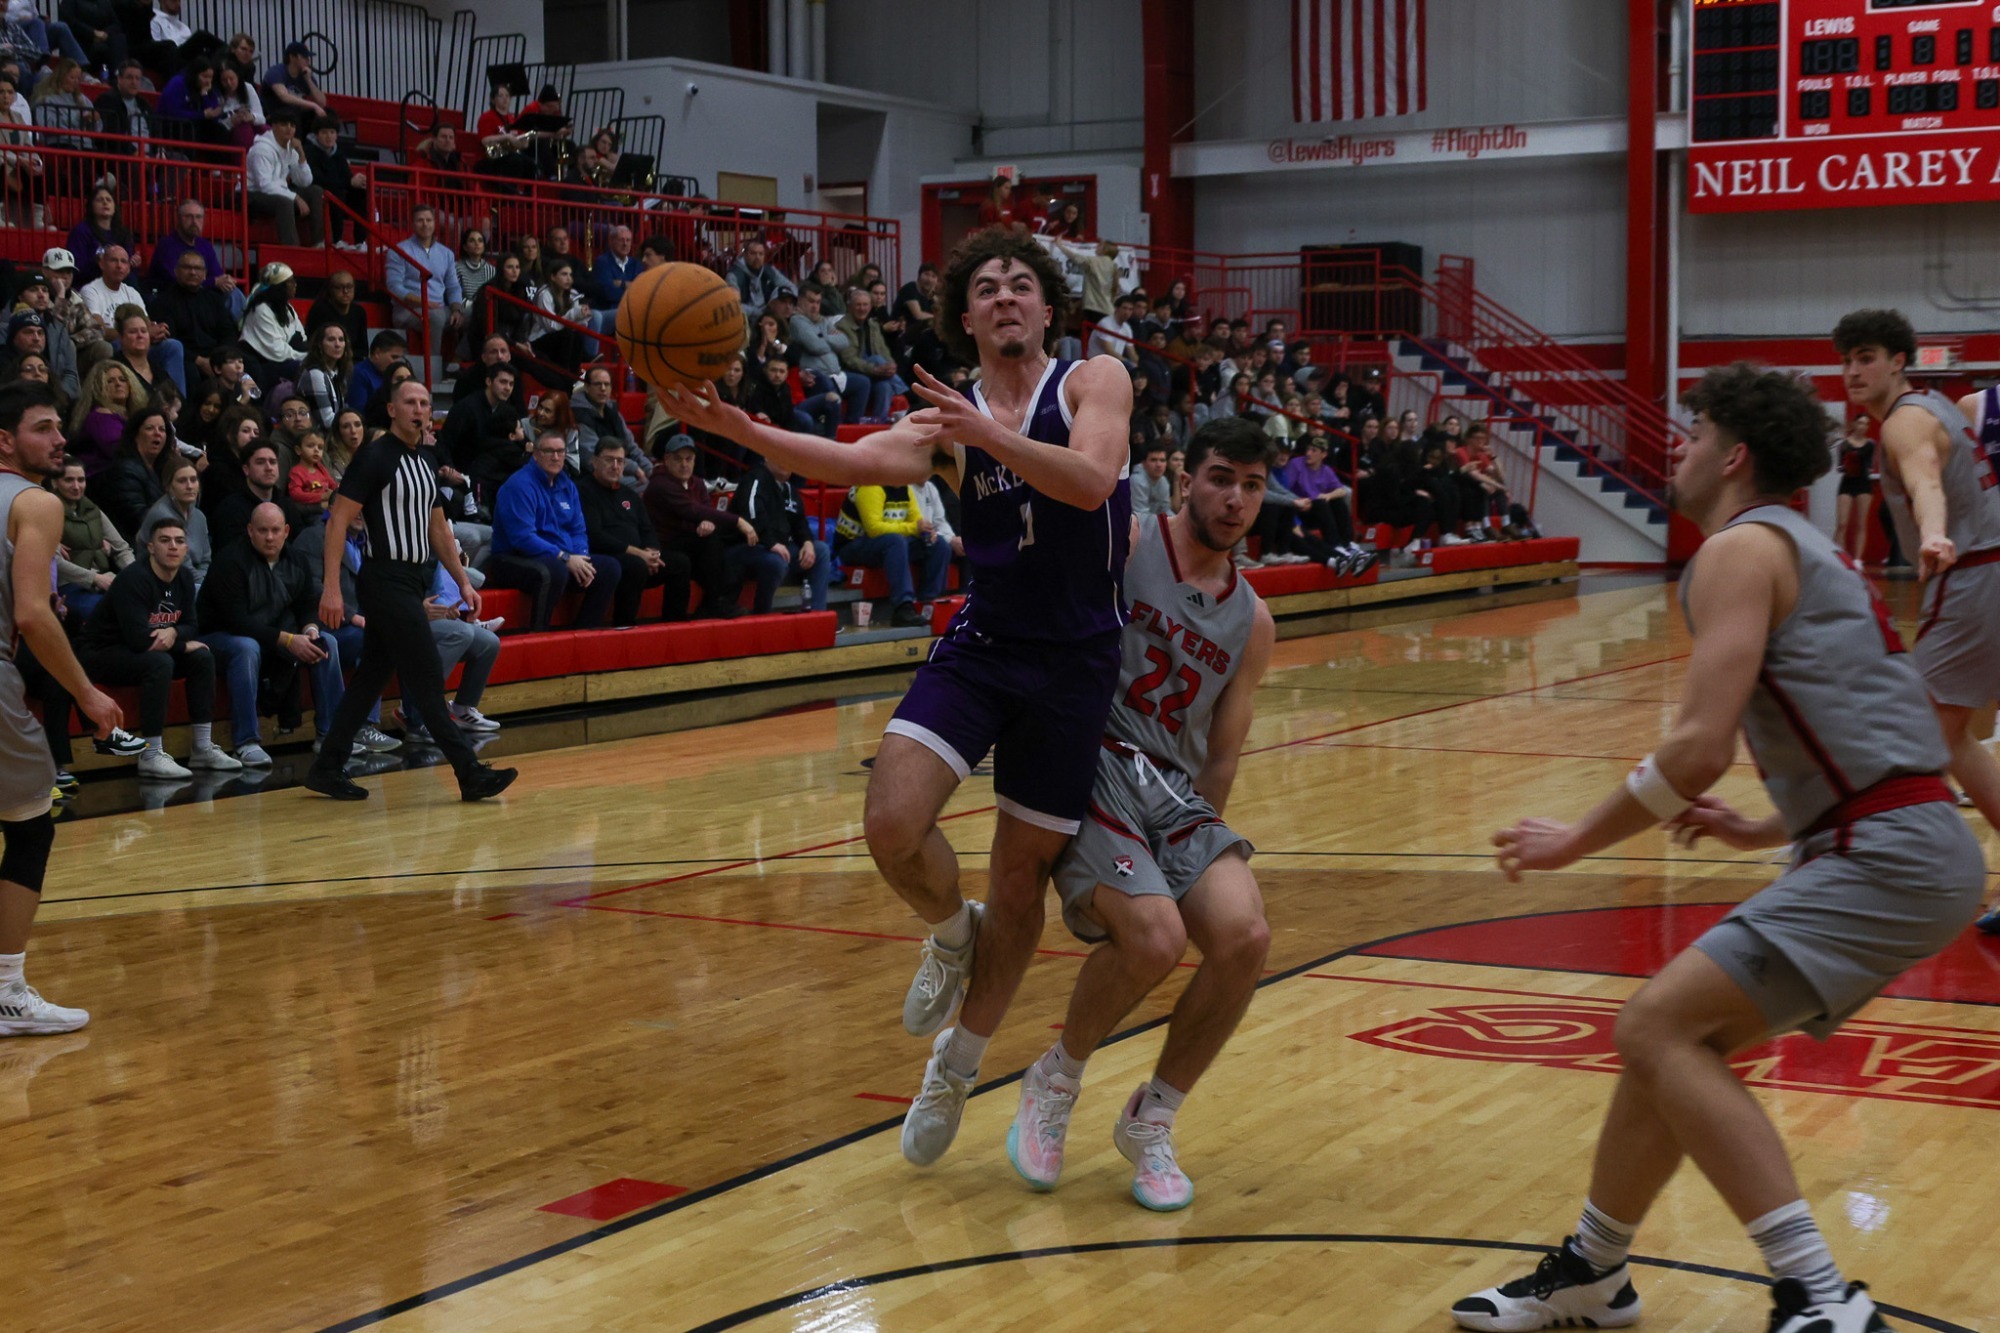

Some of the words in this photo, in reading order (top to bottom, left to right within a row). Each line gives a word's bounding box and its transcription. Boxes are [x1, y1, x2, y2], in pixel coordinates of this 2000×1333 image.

[1804, 16, 1855, 37] LEWIS
[1907, 19, 1941, 33] GAME
[1797, 77, 1833, 92] FOULS
[1884, 71, 1928, 86] PLAYER
[1932, 69, 1962, 82] FOUL
[1902, 117, 1943, 130] MATCH
[1268, 134, 1396, 165] @LewisFlyers
[1431, 124, 1527, 158] #FlightOn
[1694, 157, 1805, 197] NEIL
[1817, 147, 1982, 191] CAREY
[1128, 600, 1232, 676] FLYERS
[1121, 643, 1203, 736] 22
